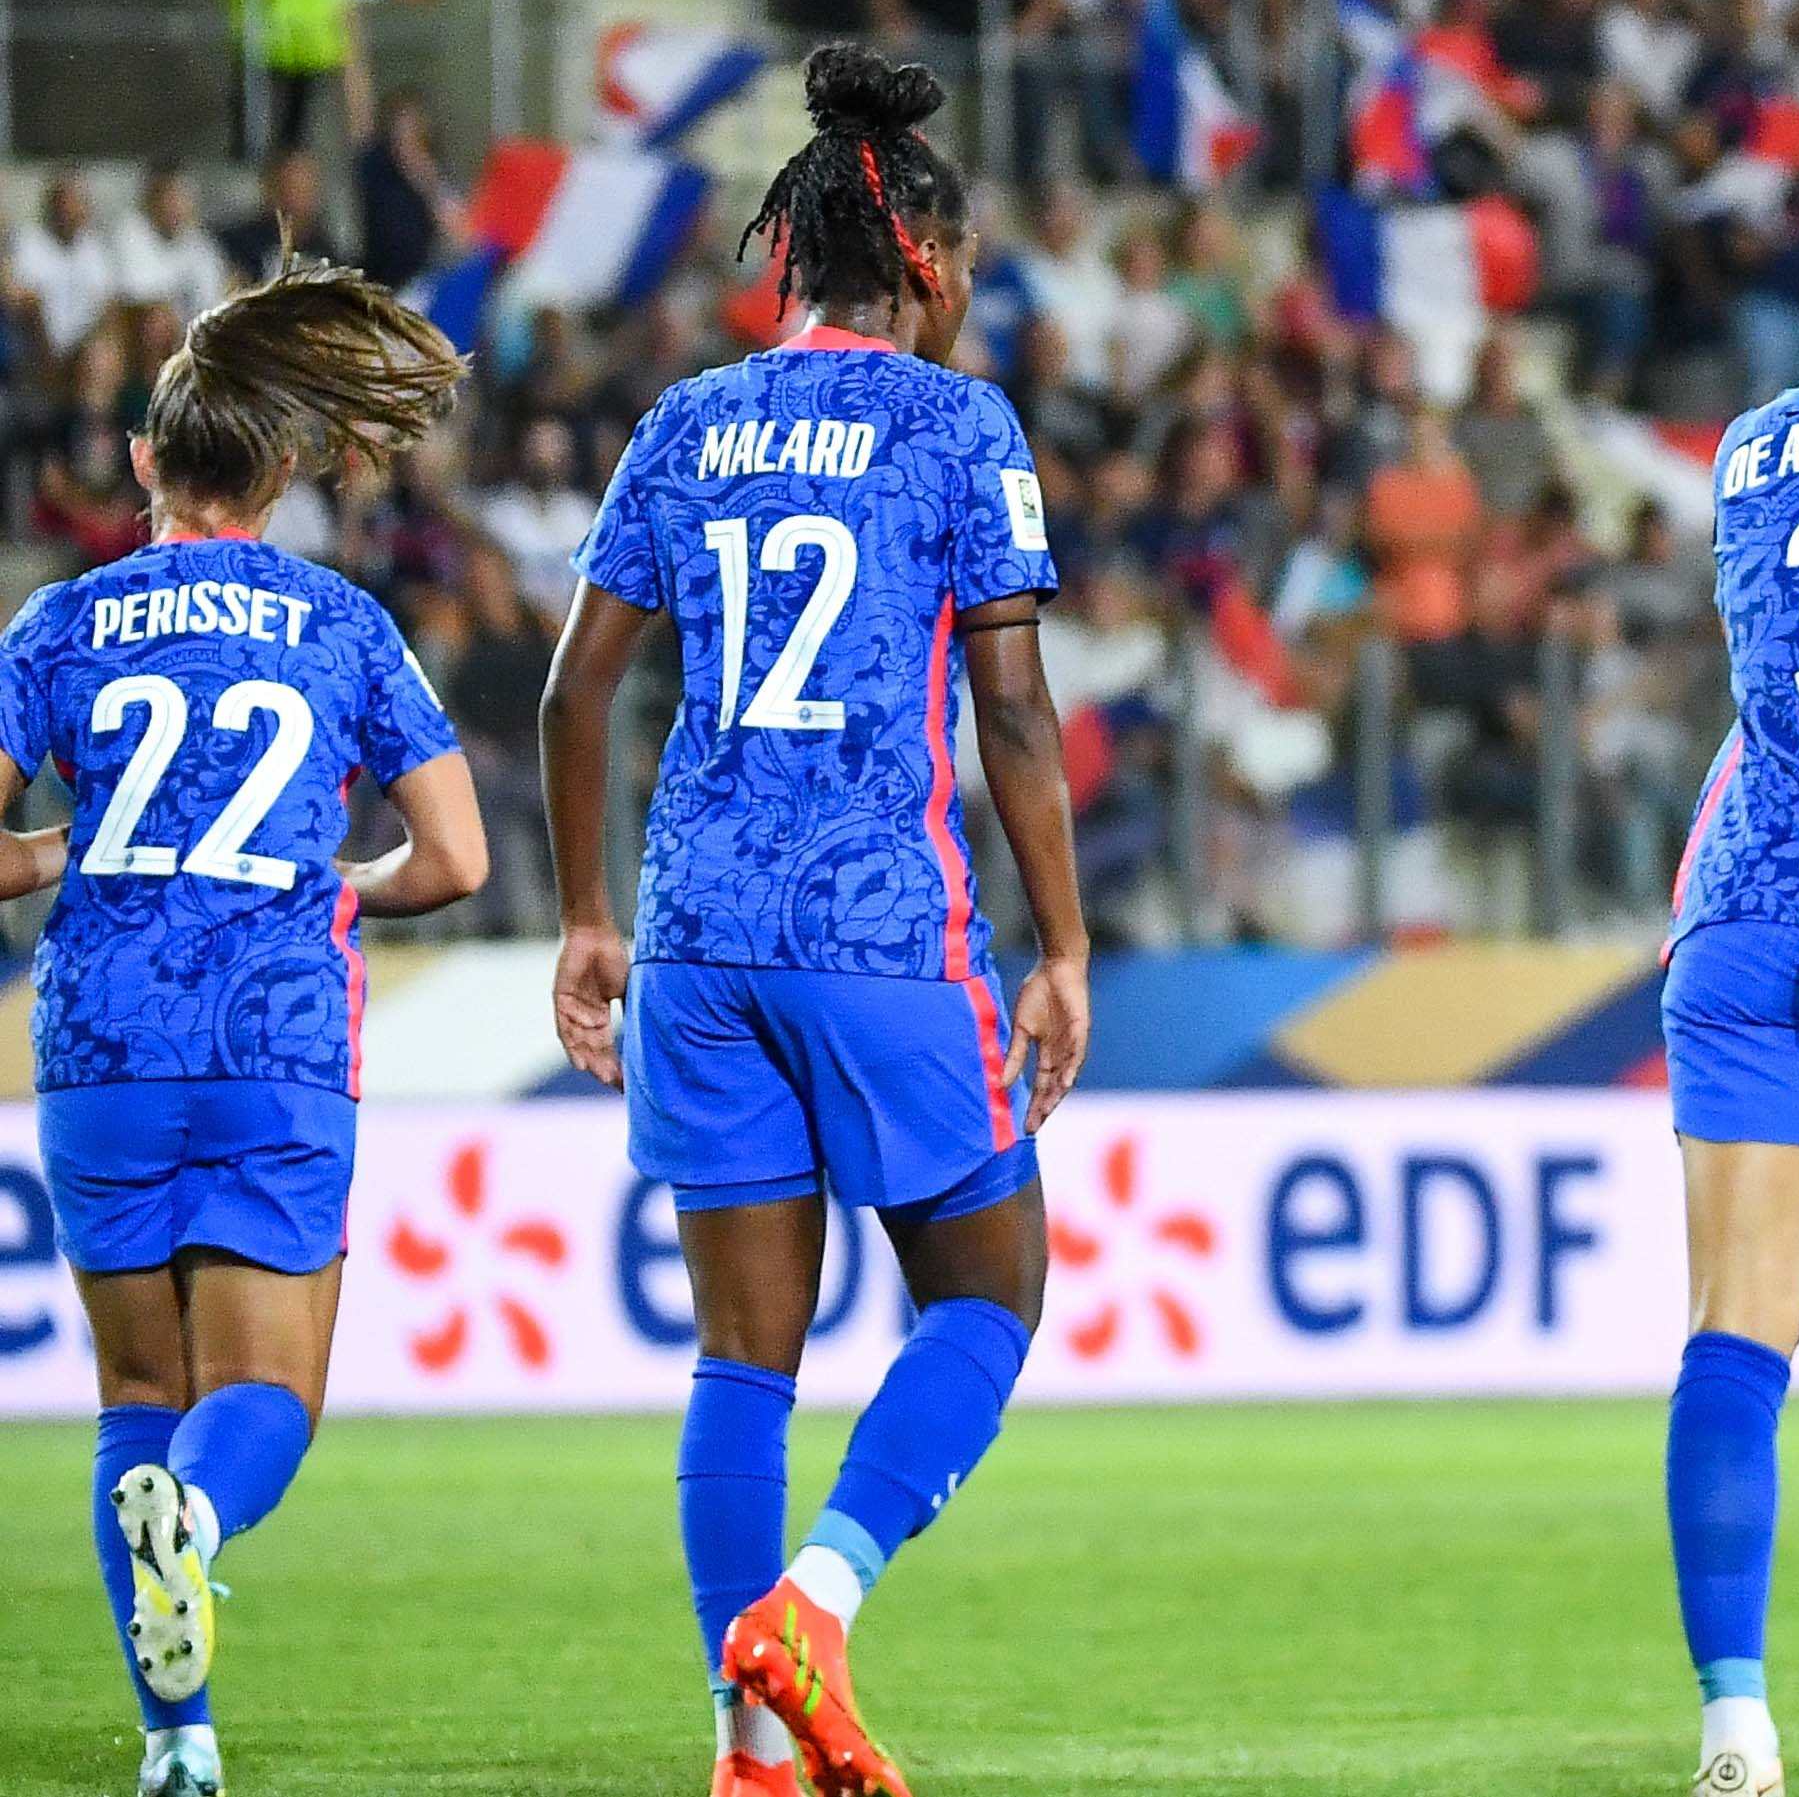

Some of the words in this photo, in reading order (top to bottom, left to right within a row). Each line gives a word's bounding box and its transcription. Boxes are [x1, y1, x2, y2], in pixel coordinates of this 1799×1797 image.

[698, 419, 875, 481] MALARD
[1723, 440, 1772, 499] DE
[92, 580, 312, 649] PERISSET
[704, 514, 857, 731] 12
[80, 674, 314, 890] 22
[1264, 1152, 1602, 1338] eDF
